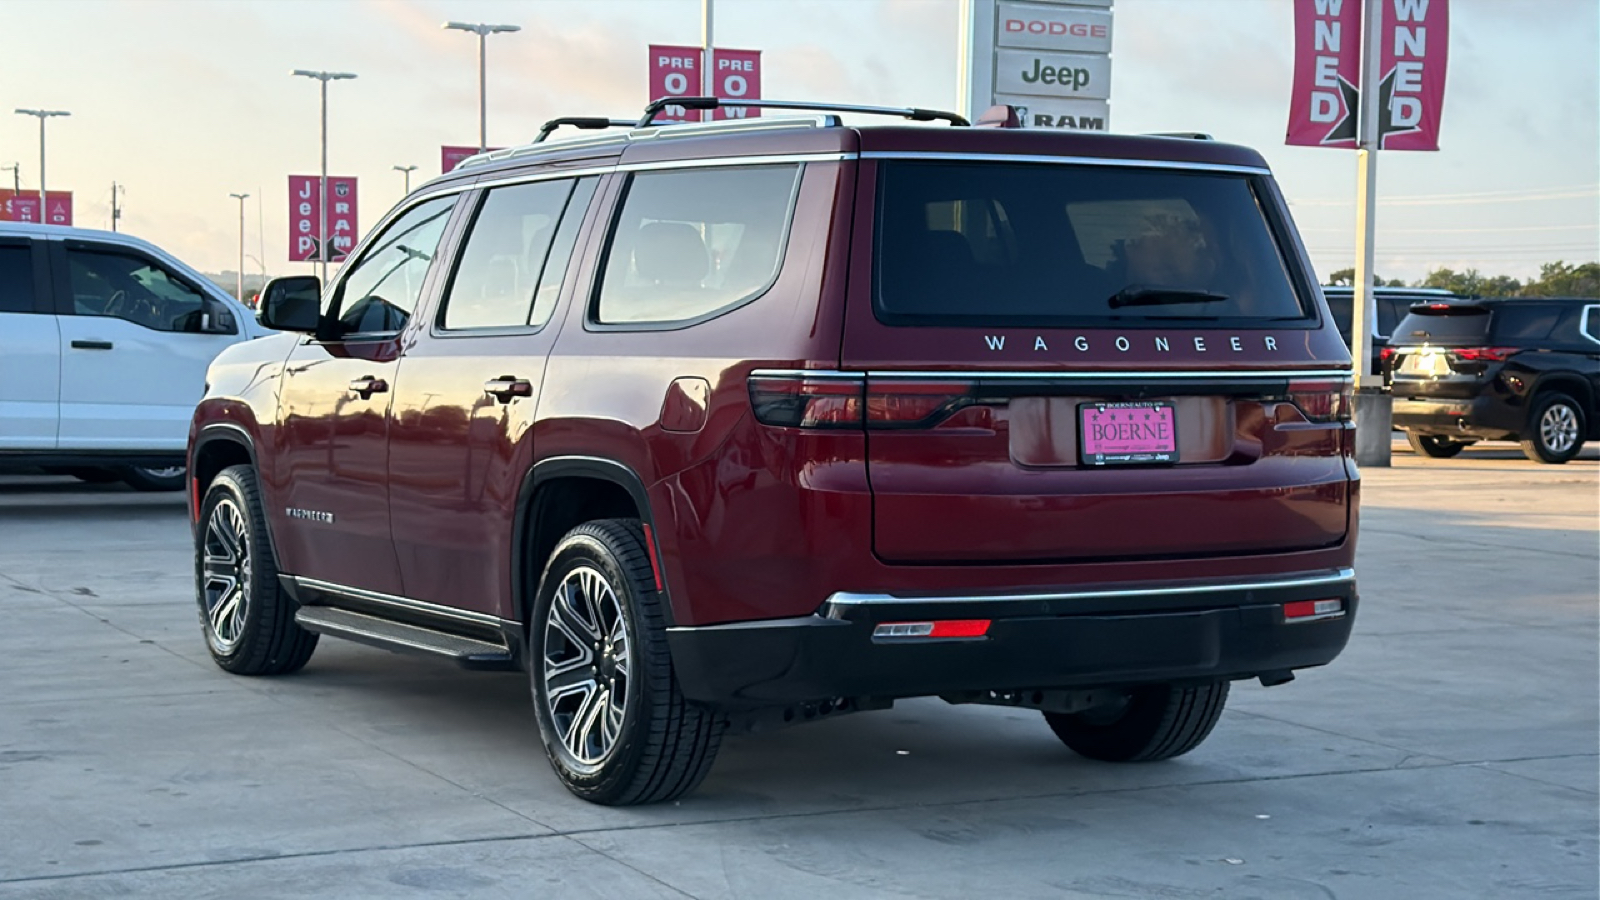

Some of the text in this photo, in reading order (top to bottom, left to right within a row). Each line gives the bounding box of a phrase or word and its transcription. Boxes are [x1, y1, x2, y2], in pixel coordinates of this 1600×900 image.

[1005, 19, 1107, 38] DODGE
[658, 55, 694, 69] PRE
[719, 58, 754, 71] PRE
[1021, 58, 1090, 91] Jeep
[1034, 114, 1104, 130] RAM
[298, 180, 312, 254] Jeep
[333, 202, 352, 247] RAM
[984, 334, 1279, 352] WAGONEER
[1091, 422, 1170, 441] BOERNE
